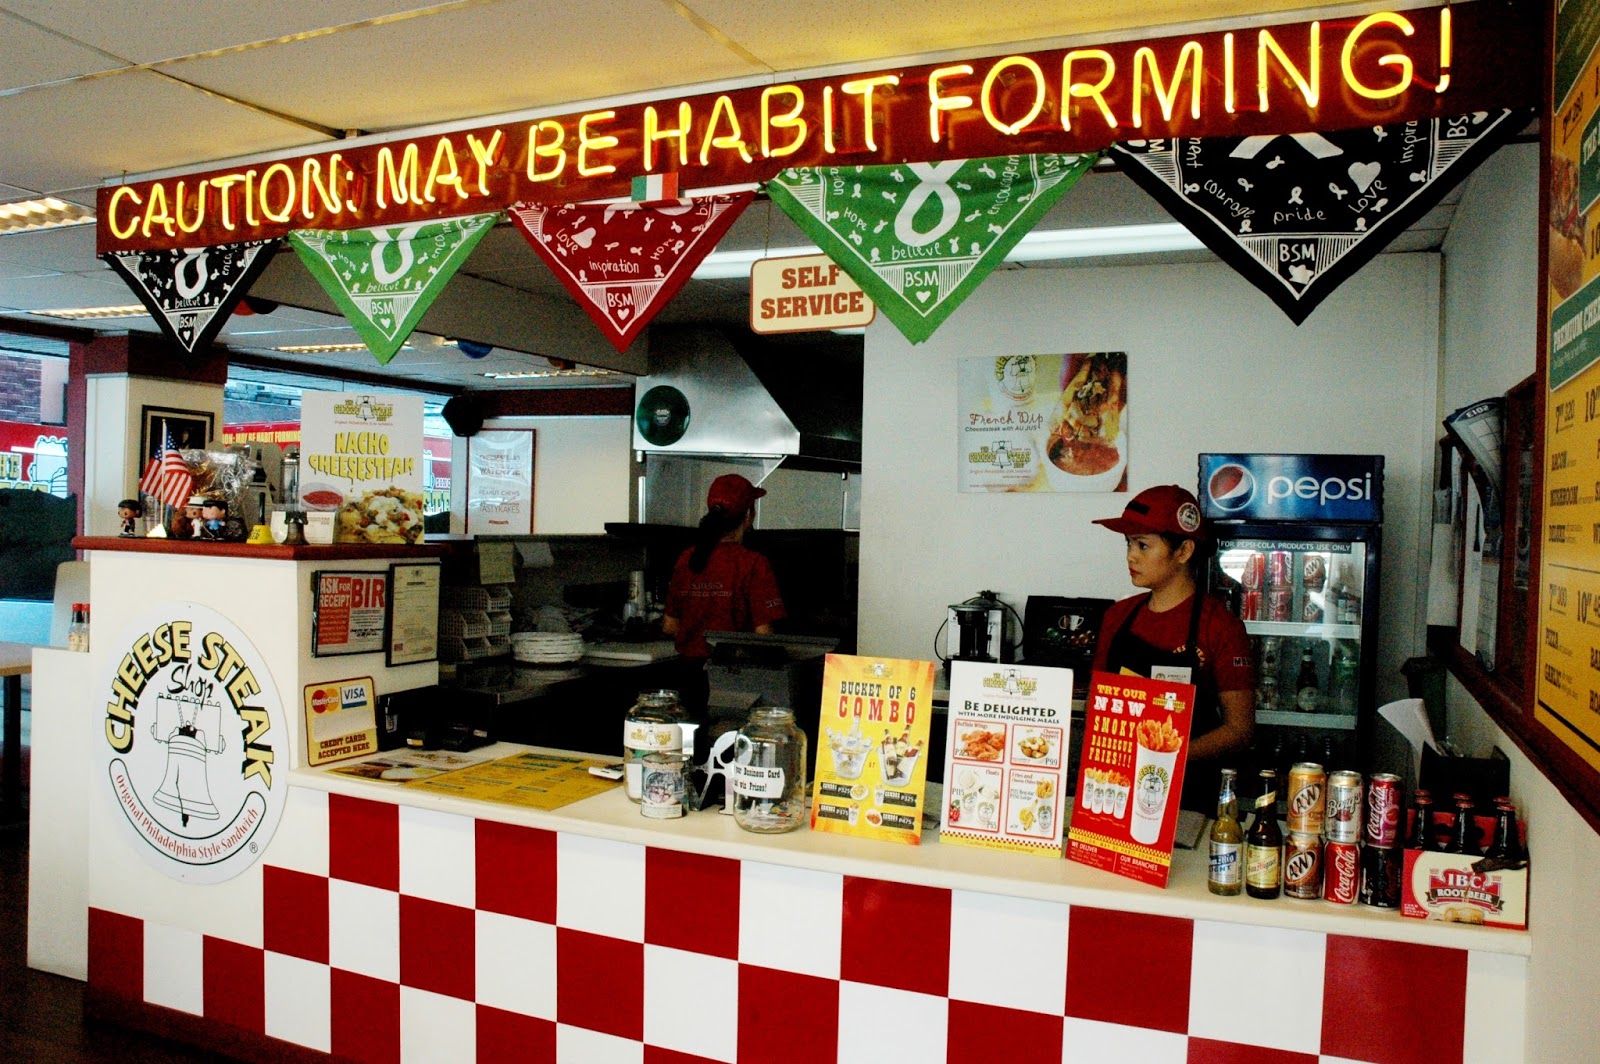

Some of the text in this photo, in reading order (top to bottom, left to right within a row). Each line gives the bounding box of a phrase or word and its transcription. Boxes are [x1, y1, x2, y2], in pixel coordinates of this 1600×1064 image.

[108, 7, 1451, 240] CAUTION: MAY BE HABIT FORMING!
[1273, 208, 1326, 224] pride
[891, 243, 940, 260] believe
[1279, 243, 1315, 262] BSM
[589, 257, 640, 279] inspiration
[781, 265, 841, 288] SELF
[905, 271, 939, 288] BSM
[372, 301, 394, 315] BSM
[607, 292, 634, 307] BSM
[760, 291, 865, 320] SERVICE
[179, 316, 197, 328] BSM
[335, 432, 390, 455] NACHO
[309, 455, 415, 482] CHEESESTEAK
[1268, 472, 1371, 506] pepsi
[320, 578, 385, 608] ASK FOR BIR
[320, 594, 350, 608] RECEIPT
[167, 664, 214, 712] Shop
[344, 687, 366, 700] VISA
[841, 681, 916, 700] BUCKET OF 6
[1097, 684, 1147, 700] TRY OUR
[104, 621, 274, 790] CHEESE STEAK
[839, 695, 915, 724] COMBO
[984, 703, 1056, 717] DELIGHTED
[1094, 695, 1146, 717] NEW
[1093, 715, 1136, 738] SMOKY
[320, 733, 366, 749] CREDIT CARDS
[1091, 734, 1133, 753] BARBECUE
[318, 742, 370, 760] ACCEPTED HERE
[1089, 747, 1131, 768] FRIES!!!
[116, 774, 259, 861] Original Philadelphia Style Sandwich
[1448, 874, 1482, 889] IBC
[1437, 888, 1492, 902] ROOT BEER
